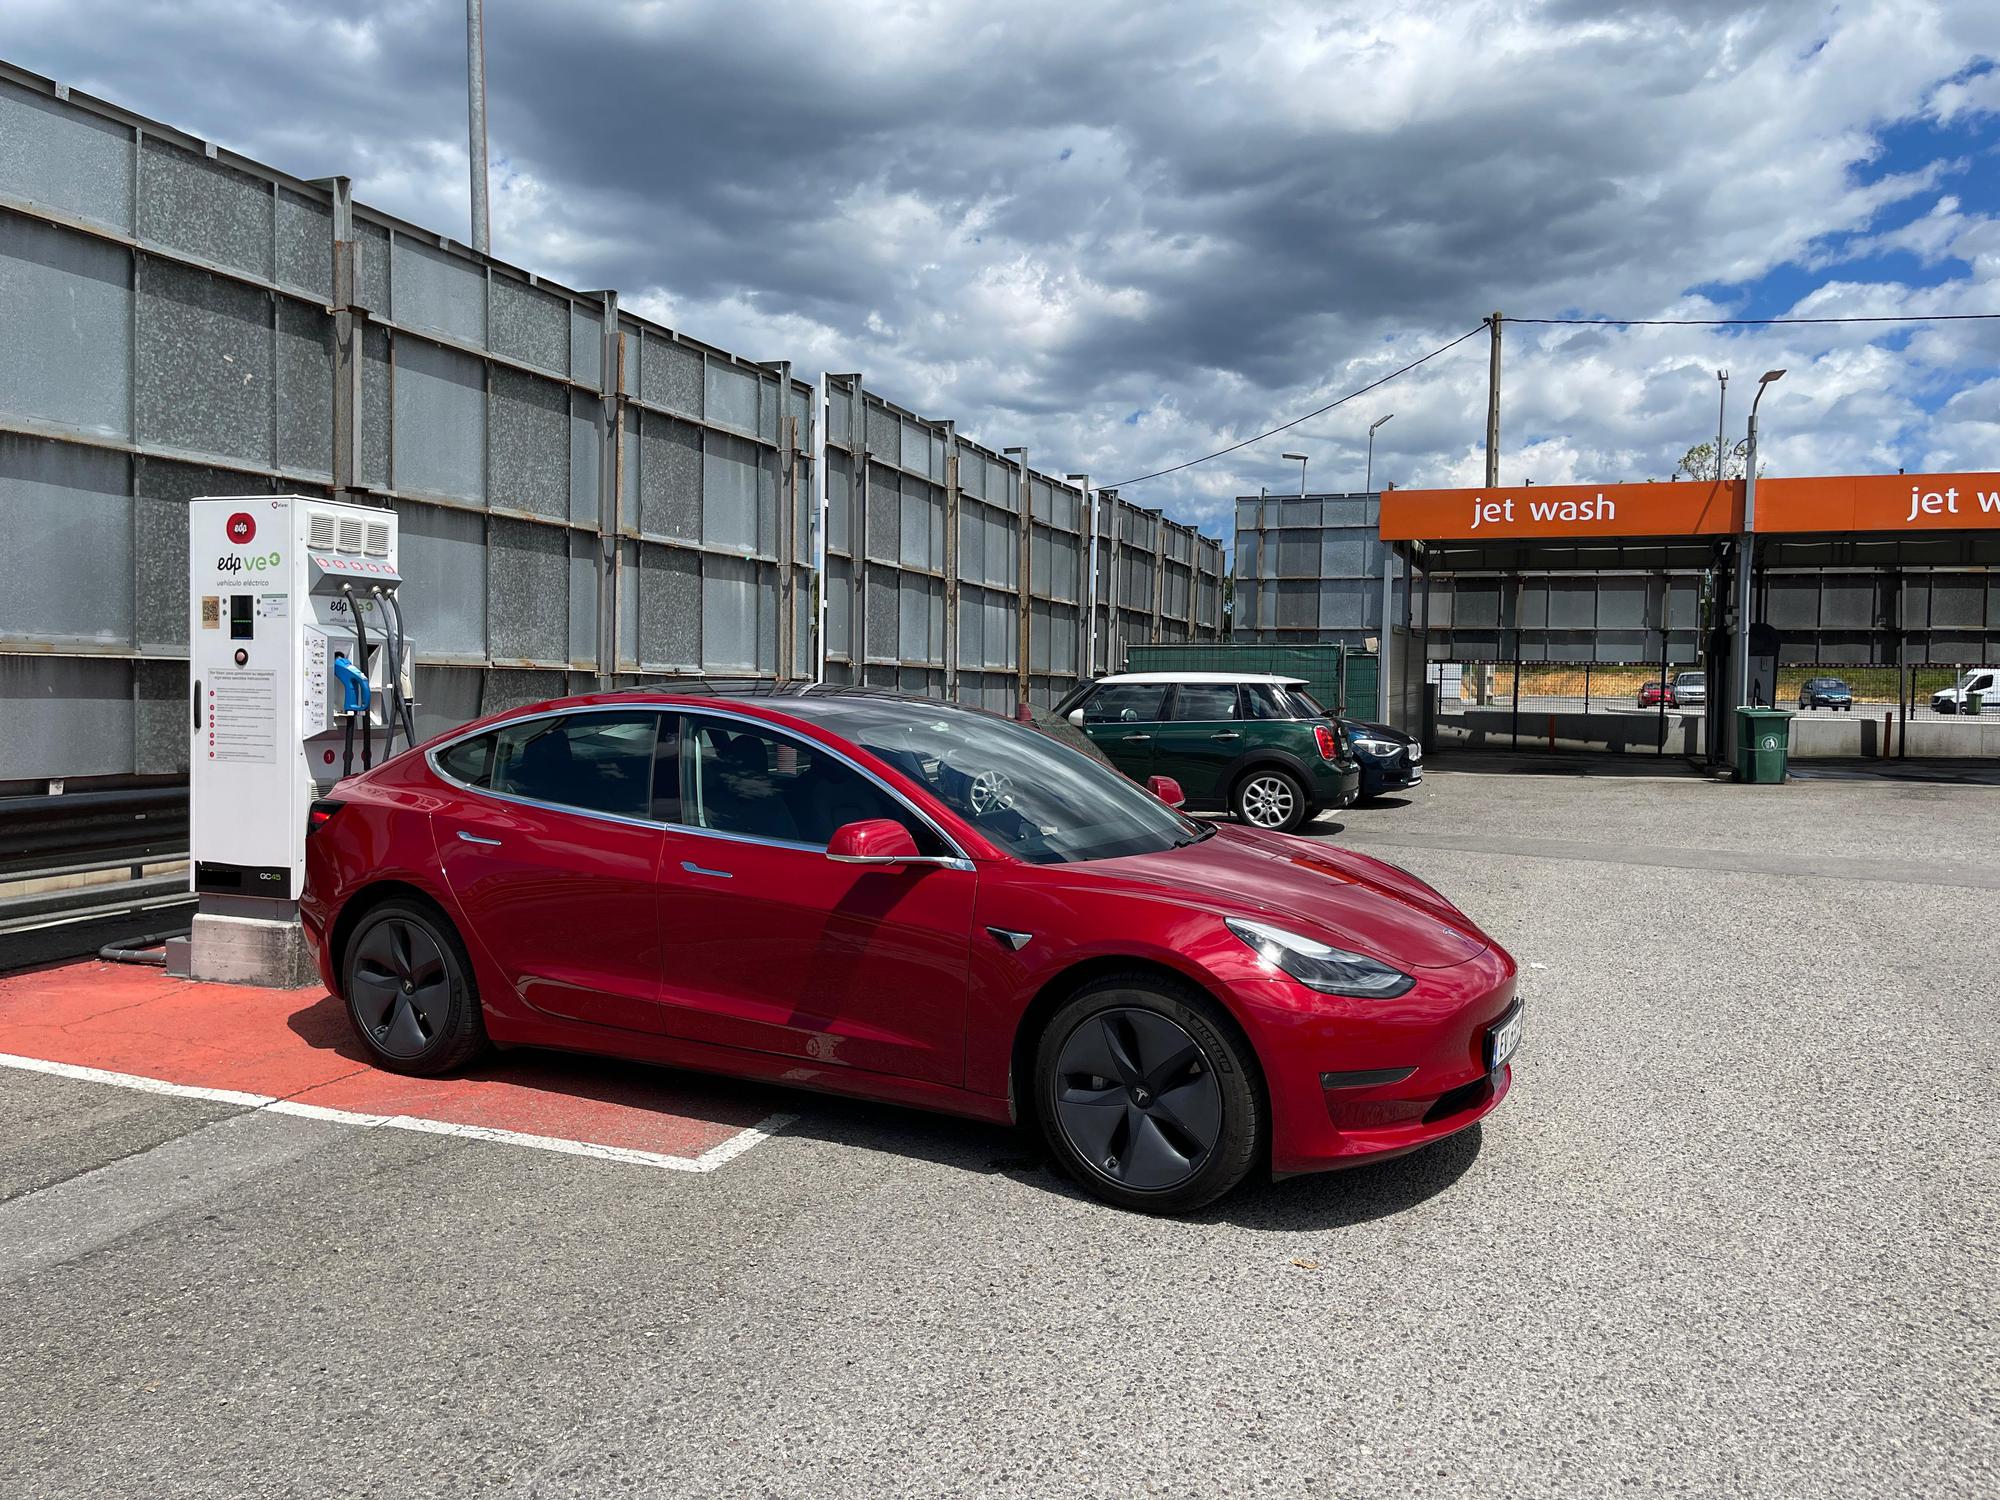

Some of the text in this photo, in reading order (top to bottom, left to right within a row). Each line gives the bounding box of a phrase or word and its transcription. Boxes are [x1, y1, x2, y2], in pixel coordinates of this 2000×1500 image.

[1470, 493, 1615, 529] jet wash
[1906, 486, 1959, 522] jet
[234, 522, 247, 534] edp
[1720, 541, 1731, 556] 7
[217, 552, 267, 575] edp ve
[216, 579, 269, 587] vehículo eléctrico
[330, 599, 347, 615] edp
